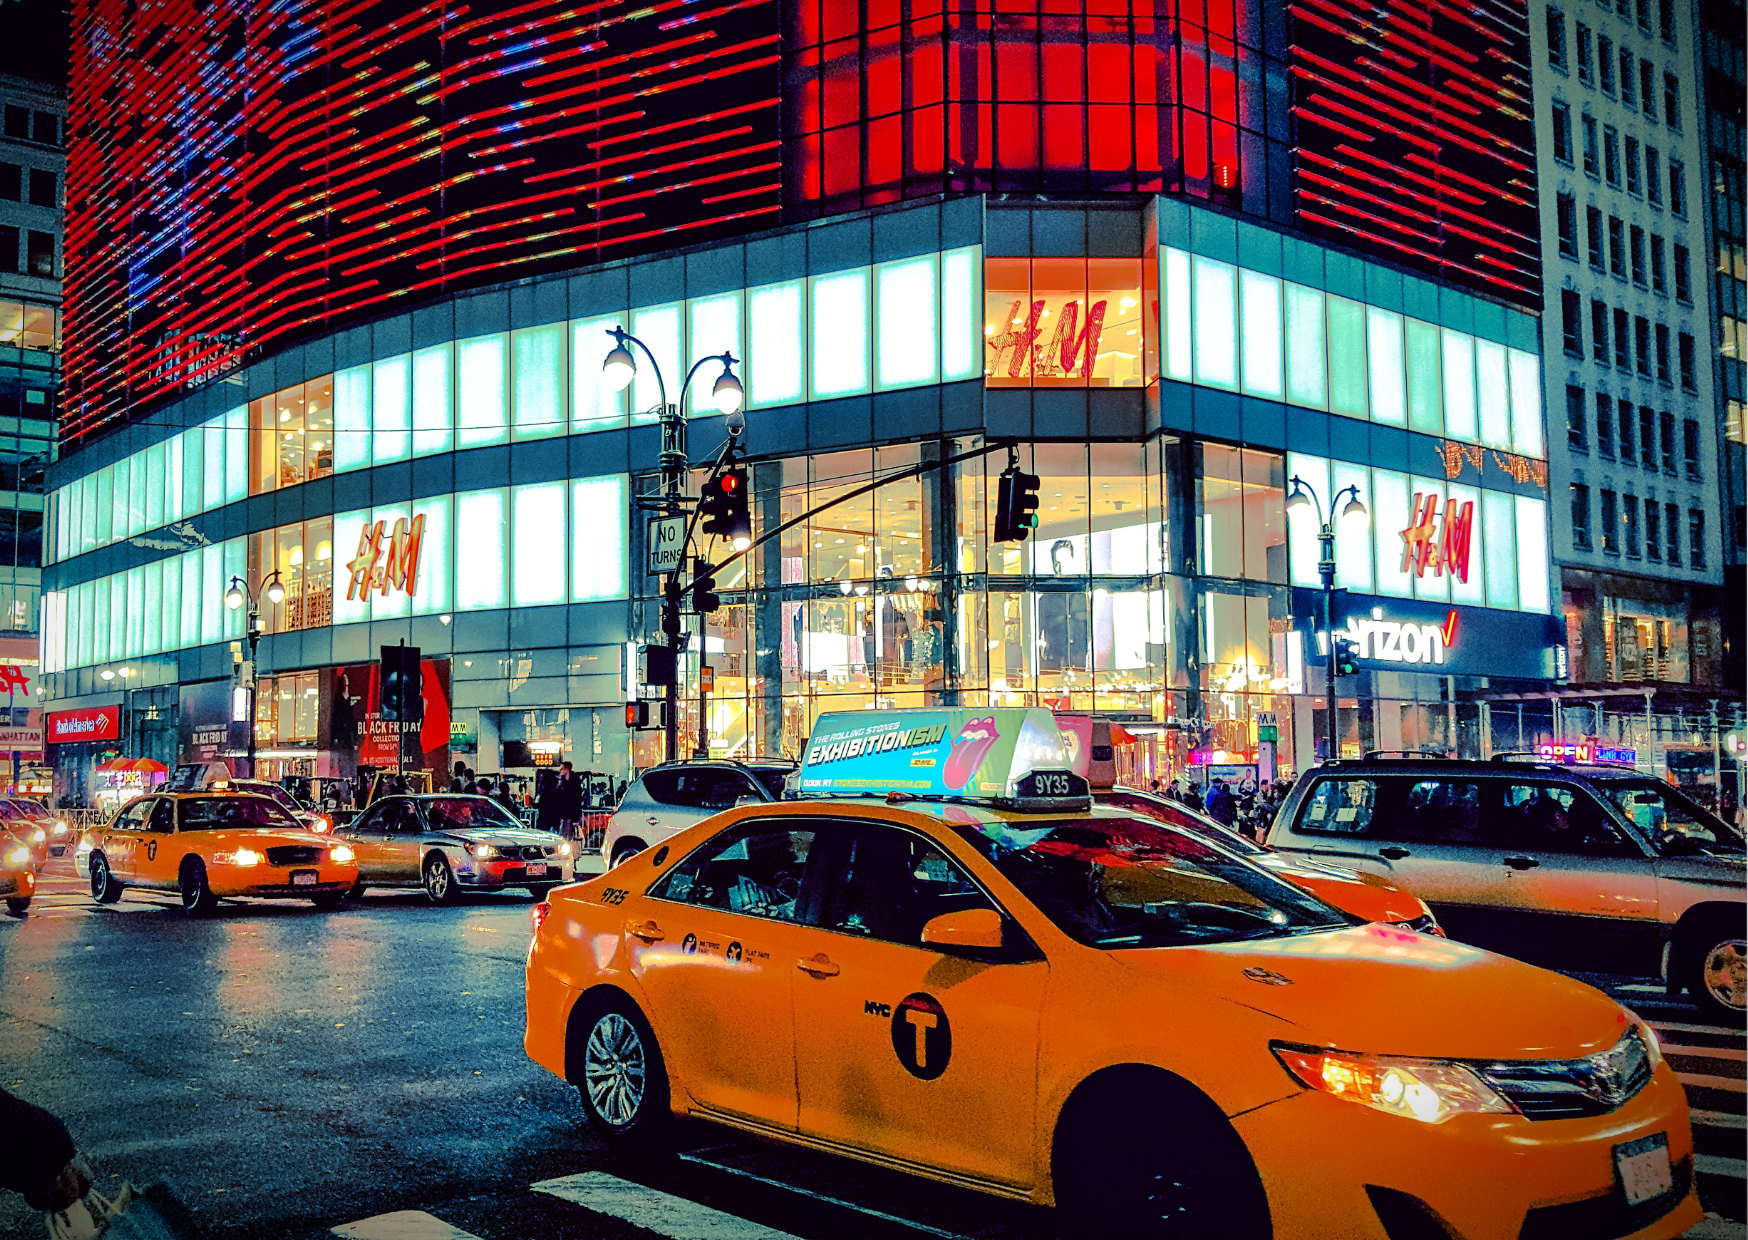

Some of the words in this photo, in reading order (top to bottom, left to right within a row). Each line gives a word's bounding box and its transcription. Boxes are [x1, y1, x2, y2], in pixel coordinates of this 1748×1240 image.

[985, 299, 1108, 378] H&M
[659, 525, 676, 543] NO
[1398, 491, 1474, 585] H&M
[345, 513, 427, 603] H&M
[652, 548, 682, 566] TURNS
[357, 720, 387, 735] BLACK
[388, 718, 422, 733] FRDAY
[814, 734, 829, 744] THE
[830, 727, 866, 741] ROLLING
[866, 721, 901, 735] STONES
[0, 731, 41, 742] NHATTAN
[372, 734, 400, 743] COLLECTIO
[807, 722, 947, 767] EXHIBITIONISM
[1540, 744, 1588, 760] OPEN
[1035, 774, 1070, 795] 9Y35
[600, 887, 630, 906] 9Y35
[864, 999, 892, 1018] NYC
